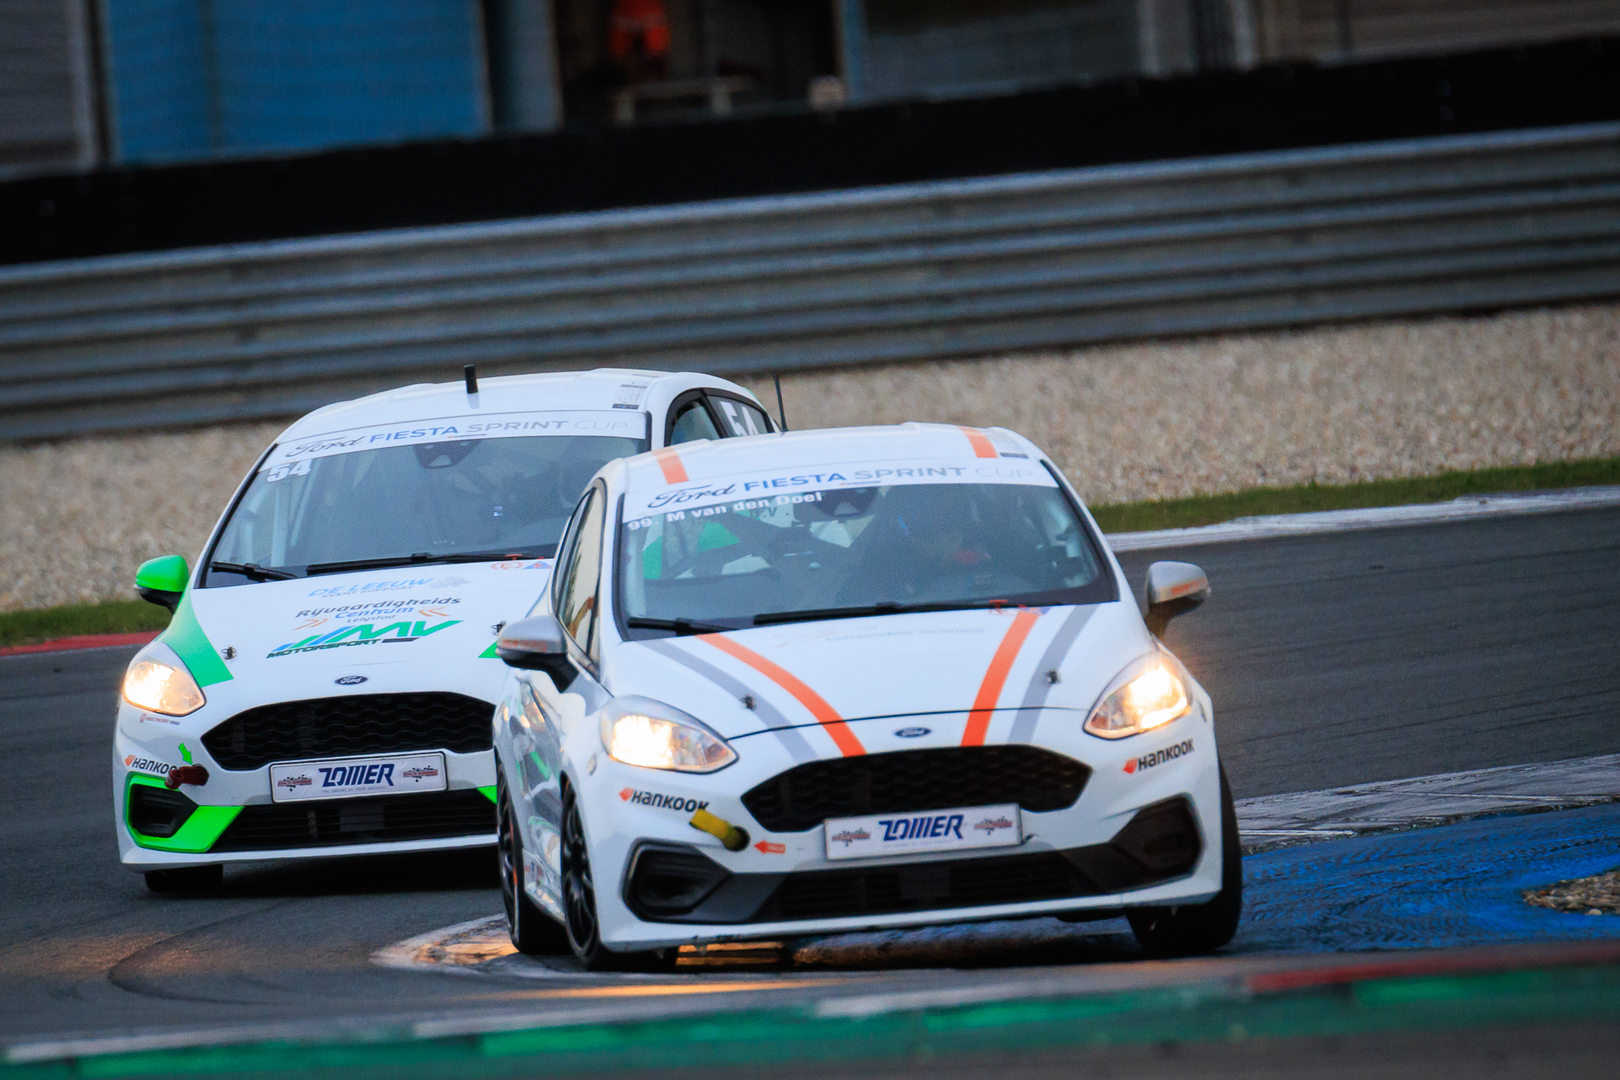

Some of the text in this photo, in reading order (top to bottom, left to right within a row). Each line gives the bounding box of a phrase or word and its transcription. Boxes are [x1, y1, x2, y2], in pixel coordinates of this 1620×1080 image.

[285, 420, 629, 458] Ford FIESTA SPRINT CUP
[266, 458, 313, 482] 54
[647, 466, 1034, 509] Ford FIESTA SPRINT CUP
[666, 512, 686, 523] M
[692, 505, 728, 518] van
[733, 499, 770, 511] den
[776, 491, 823, 506] Doel
[308, 578, 435, 597] DE LEEUW
[360, 585, 415, 594] SUPPORT
[335, 606, 415, 619] Centrum
[347, 614, 397, 623] Lelystad
[266, 638, 383, 659] MOTORSPORT
[318, 763, 395, 788] ZOMER
[878, 814, 965, 842] ZOMER
